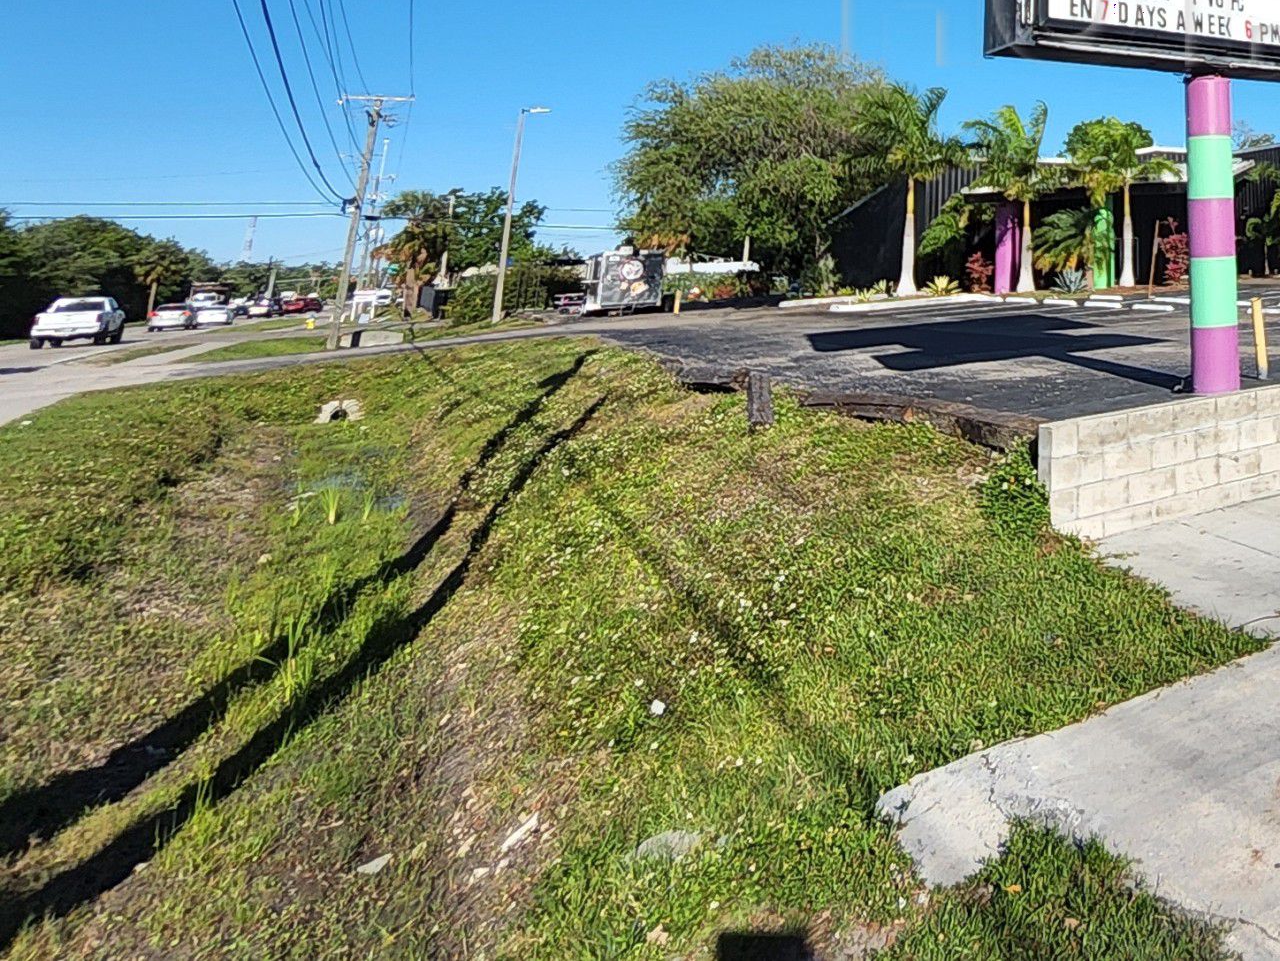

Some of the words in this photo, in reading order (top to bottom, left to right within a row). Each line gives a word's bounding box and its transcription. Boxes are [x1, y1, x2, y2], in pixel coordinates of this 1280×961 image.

[1100, 0, 1109, 21] 7
[1118, 1, 1167, 28] DAYS
[1177, 9, 1186, 31] A
[1192, 11, 1232, 37] WEEK
